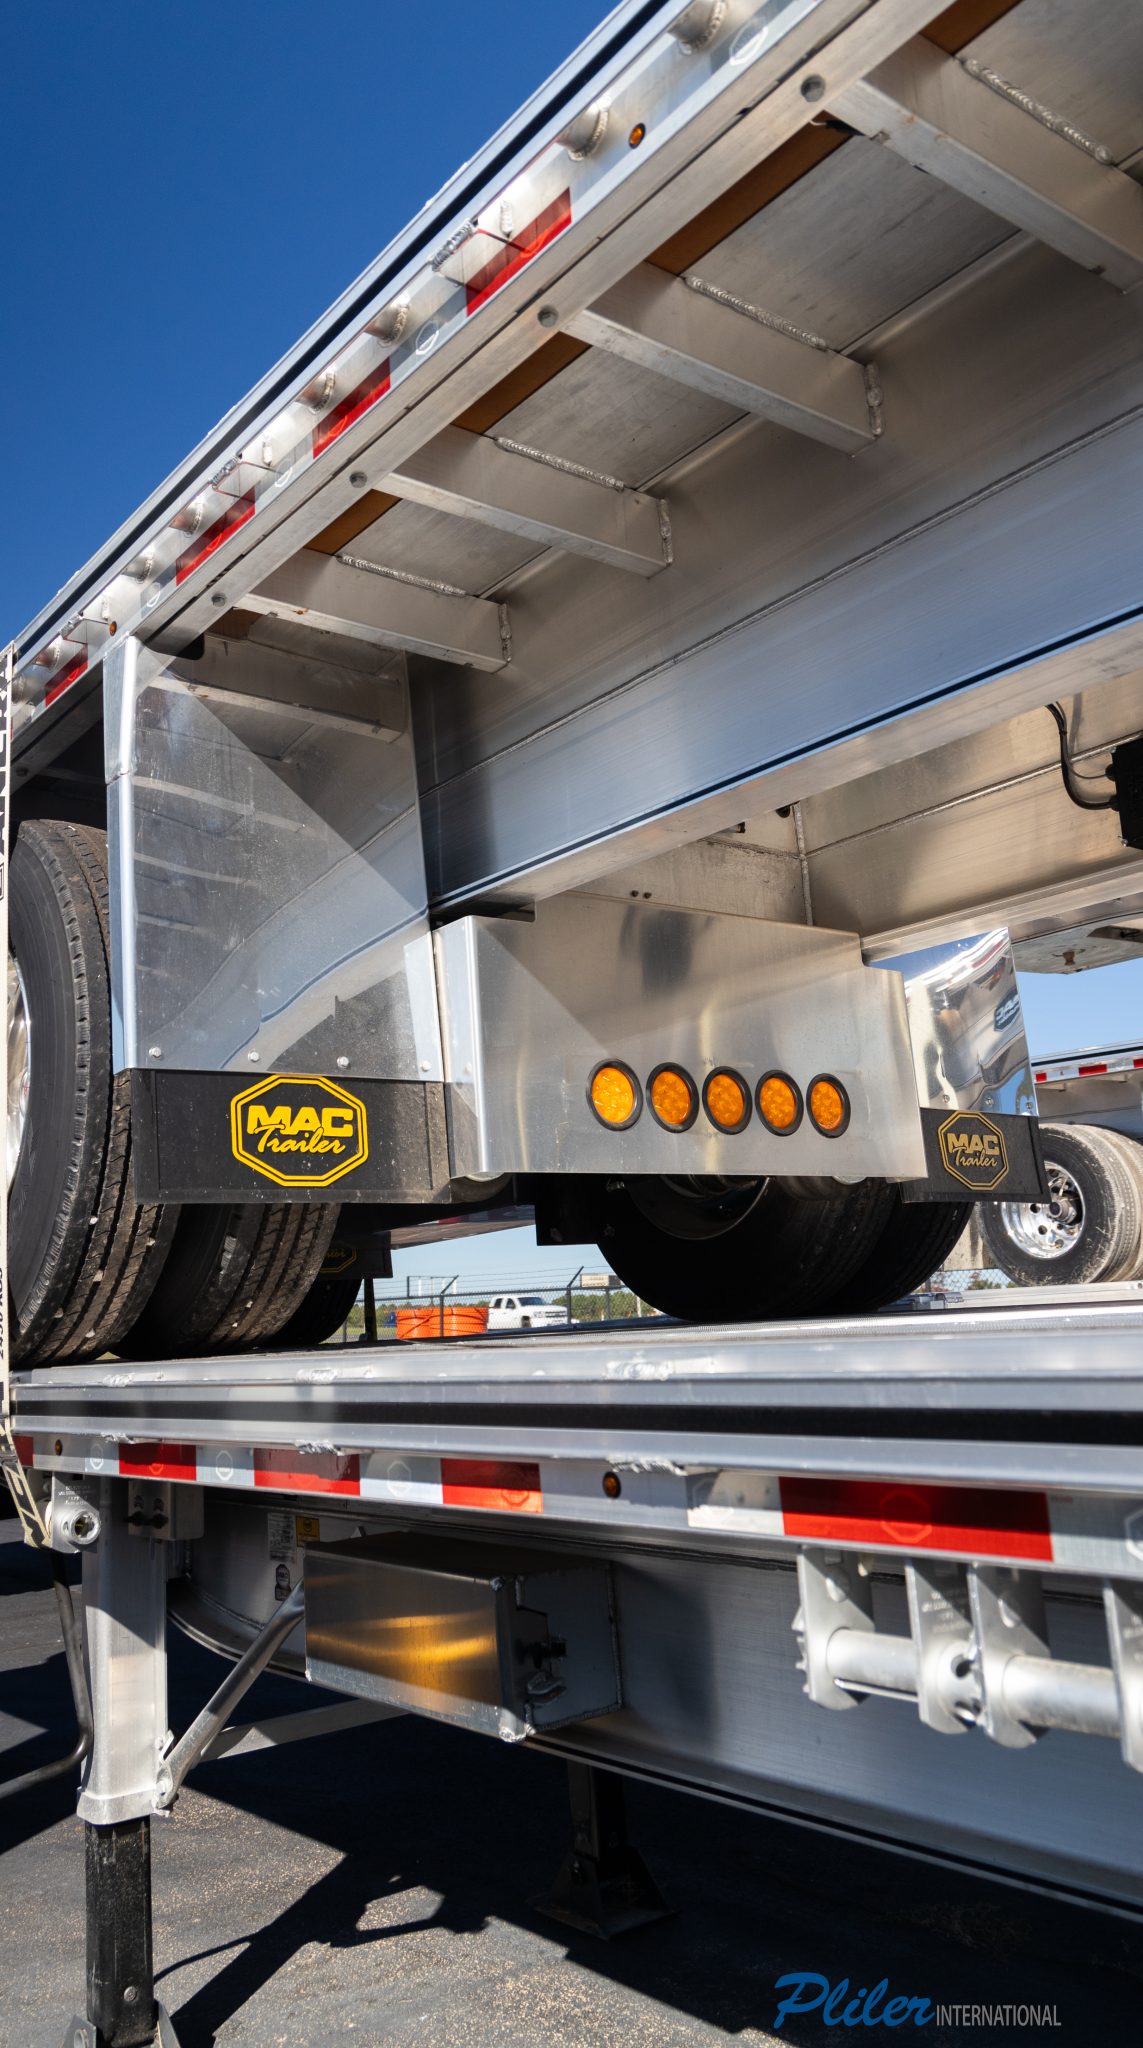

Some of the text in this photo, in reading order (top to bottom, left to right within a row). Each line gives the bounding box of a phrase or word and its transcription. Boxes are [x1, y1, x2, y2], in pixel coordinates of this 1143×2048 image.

[246, 1105, 354, 1138] MAC
[254, 1123, 346, 1154] Trailer
[947, 1132, 1000, 1156] MAC
[952, 1146, 998, 1167] Trailer
